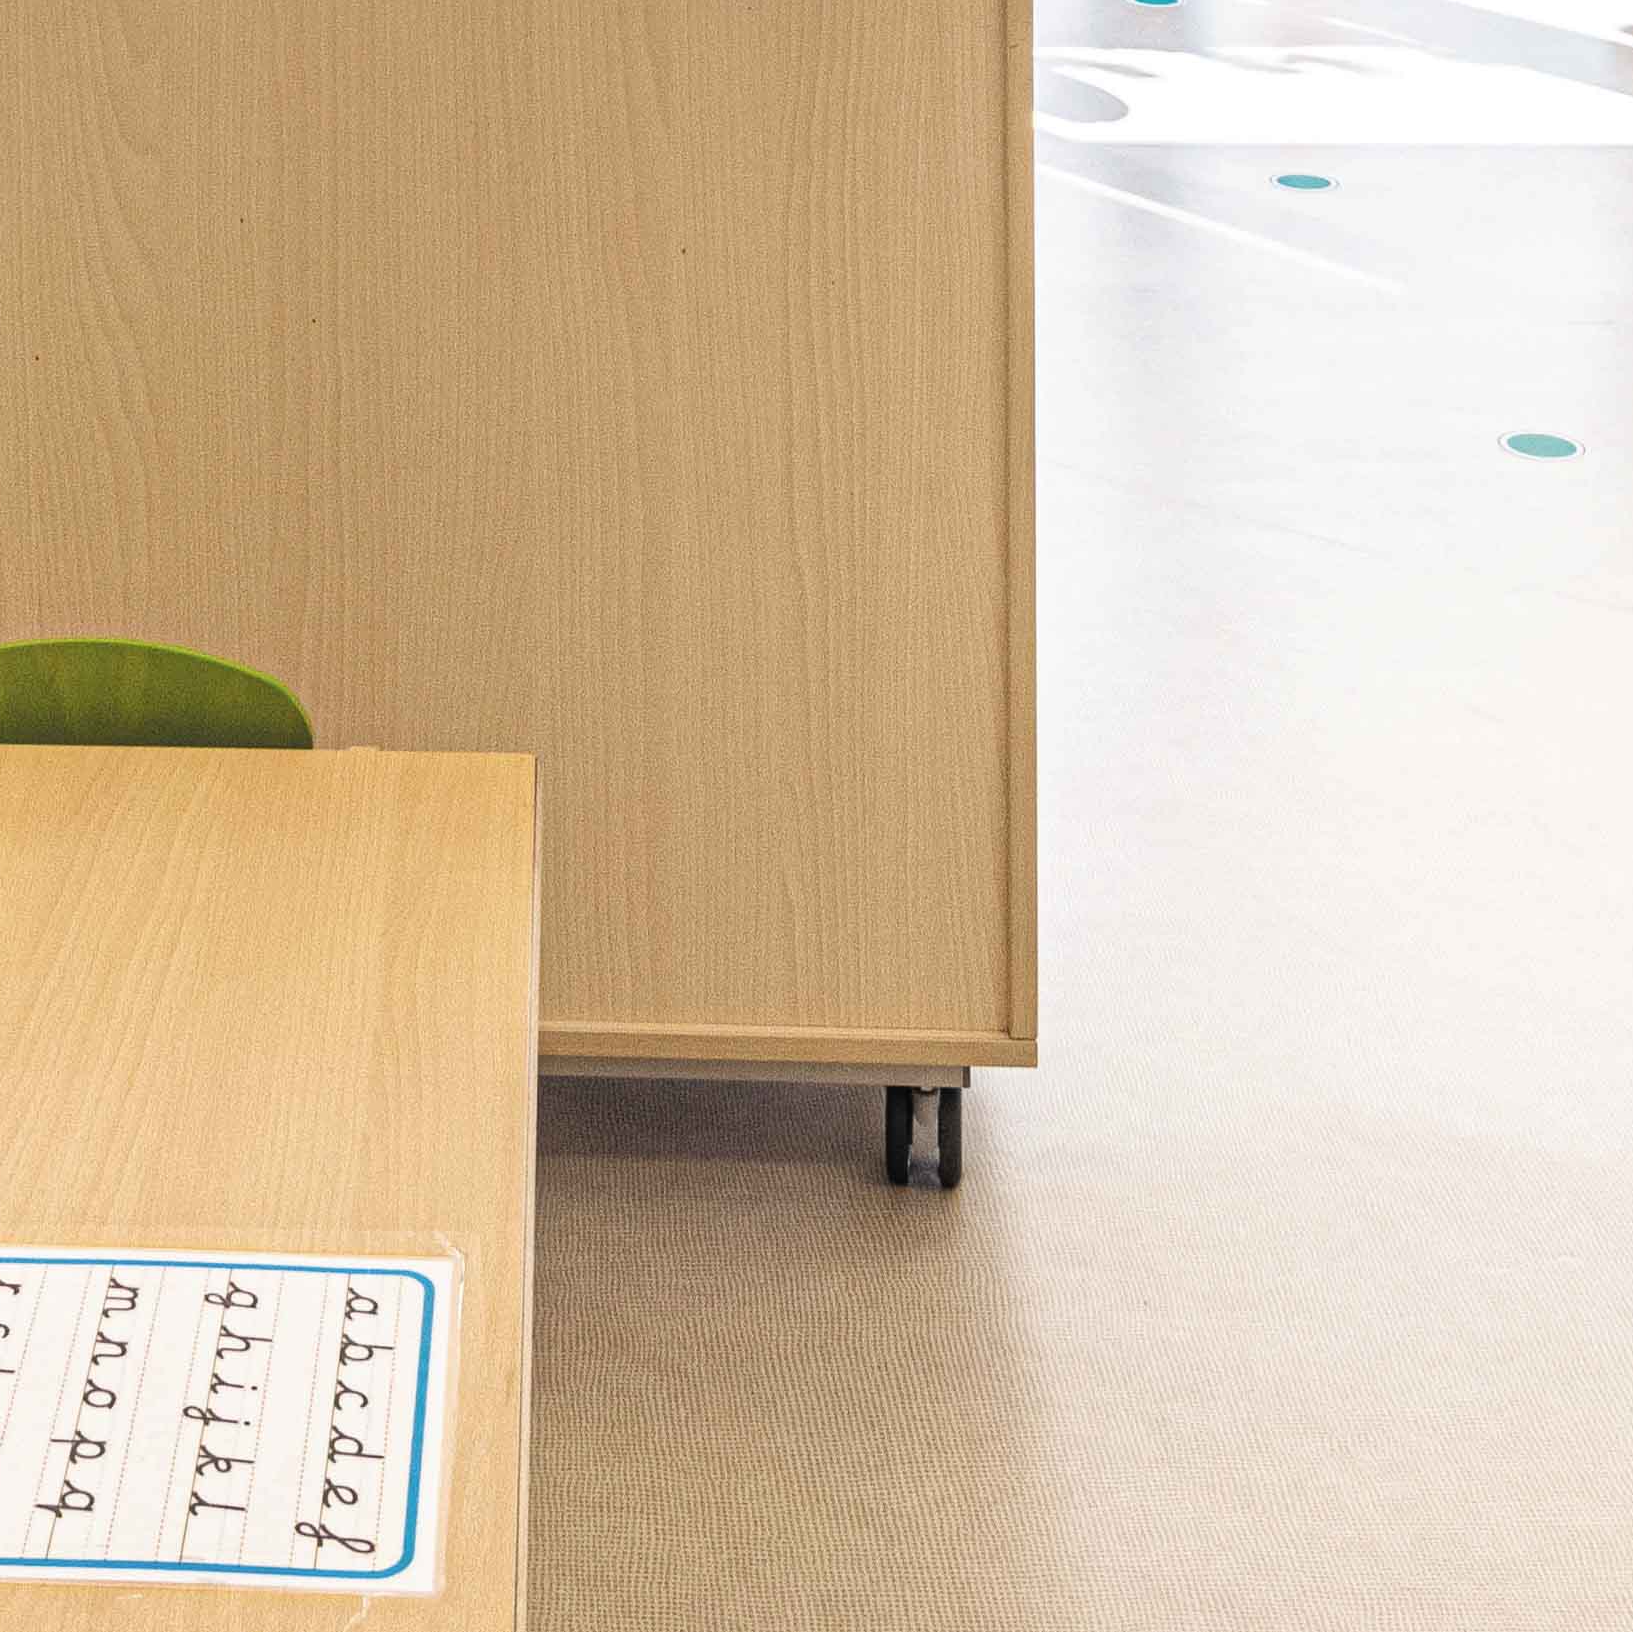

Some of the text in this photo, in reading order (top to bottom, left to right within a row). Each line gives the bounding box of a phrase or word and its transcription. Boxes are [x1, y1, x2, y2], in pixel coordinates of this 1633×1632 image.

[35, 1278, 140, 1518] m n o p q
[183, 1281, 273, 1516] g h i j k l
[294, 1287, 394, 1554] a b c d e f
